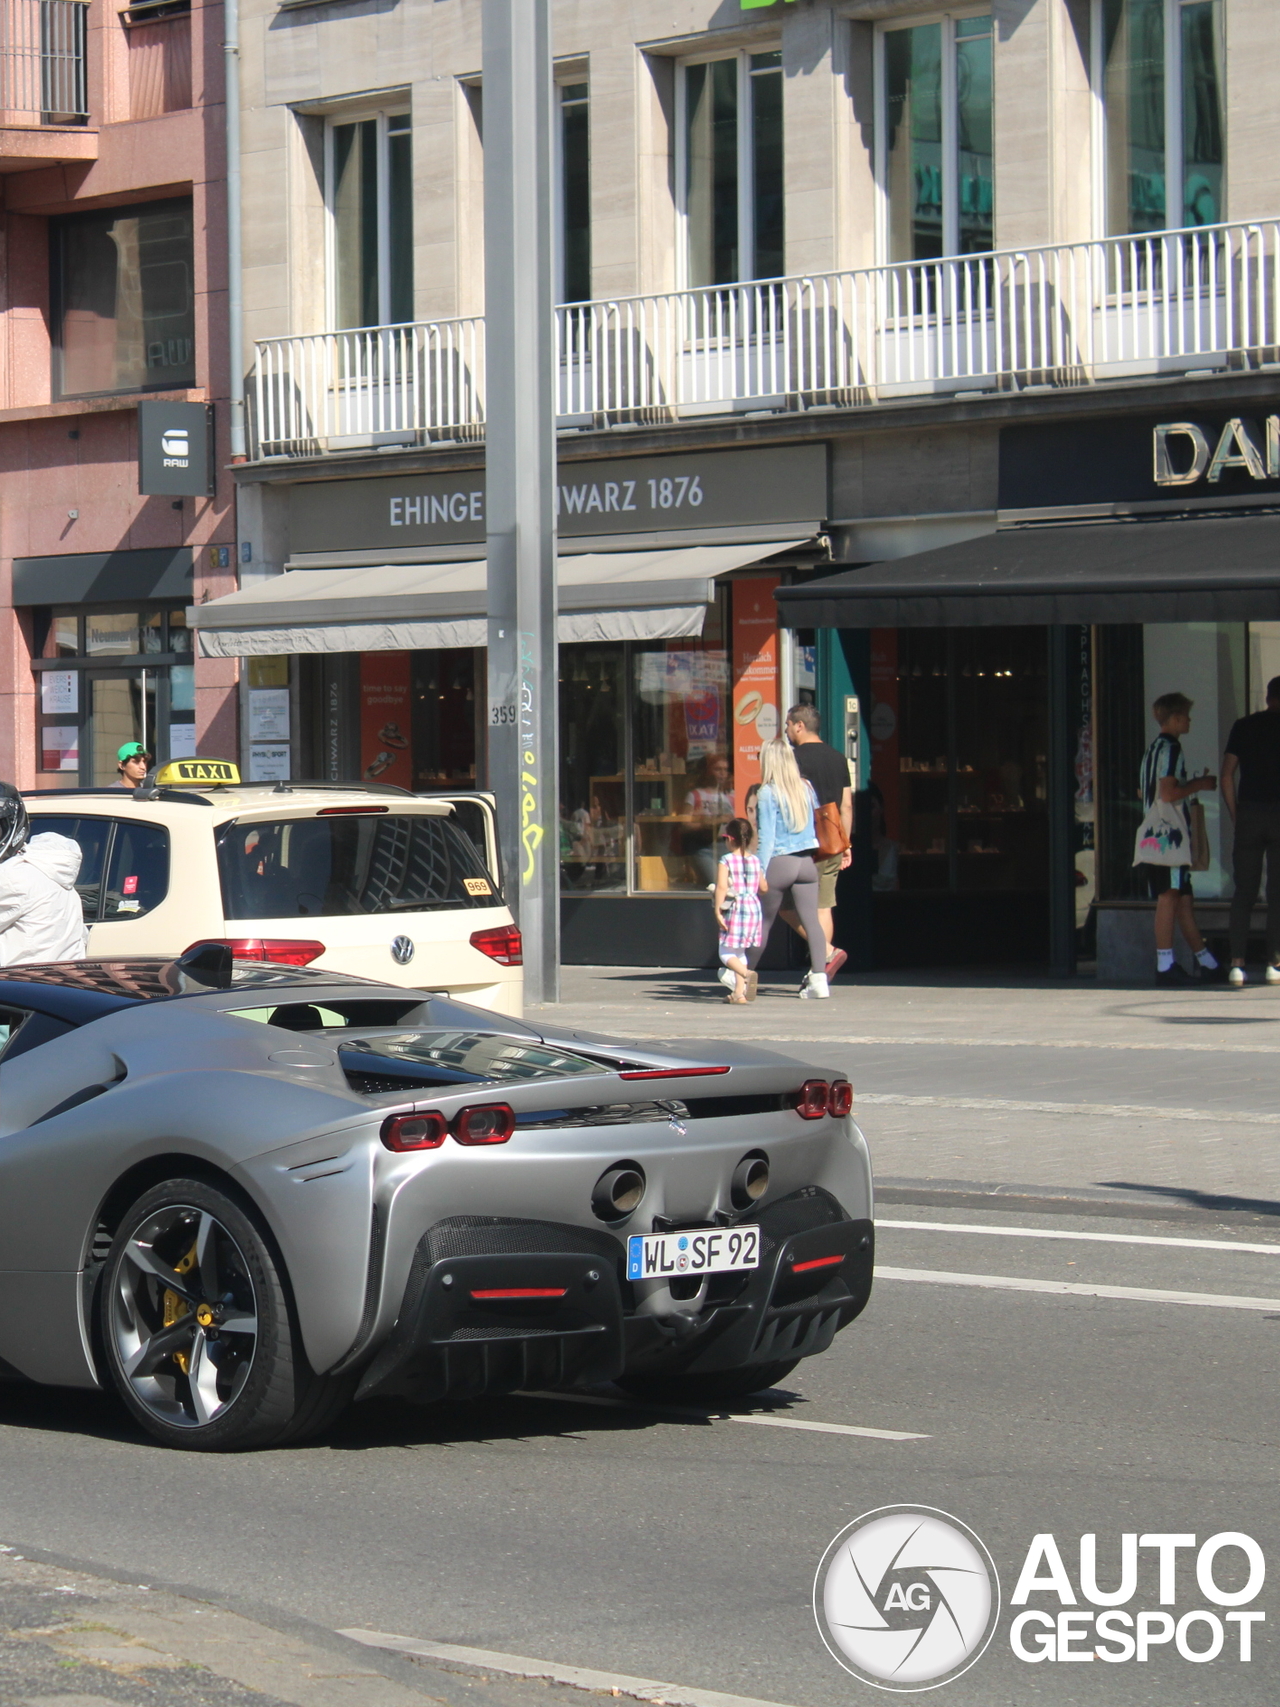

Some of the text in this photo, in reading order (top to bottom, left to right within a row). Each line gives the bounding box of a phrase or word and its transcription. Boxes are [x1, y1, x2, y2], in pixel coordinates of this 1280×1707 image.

[163, 458, 189, 467] RAW
[389, 476, 704, 526] EHINGE WARZ 1876
[330, 682, 338, 712] 1876
[367, 695, 403, 705] goodbye
[492, 704, 517, 724] 359
[330, 719, 339, 781] CHWARZ
[184, 764, 227, 778] TAXI
[467, 881, 488, 891] 969
[632, 1231, 757, 1274] D WL SF 92
